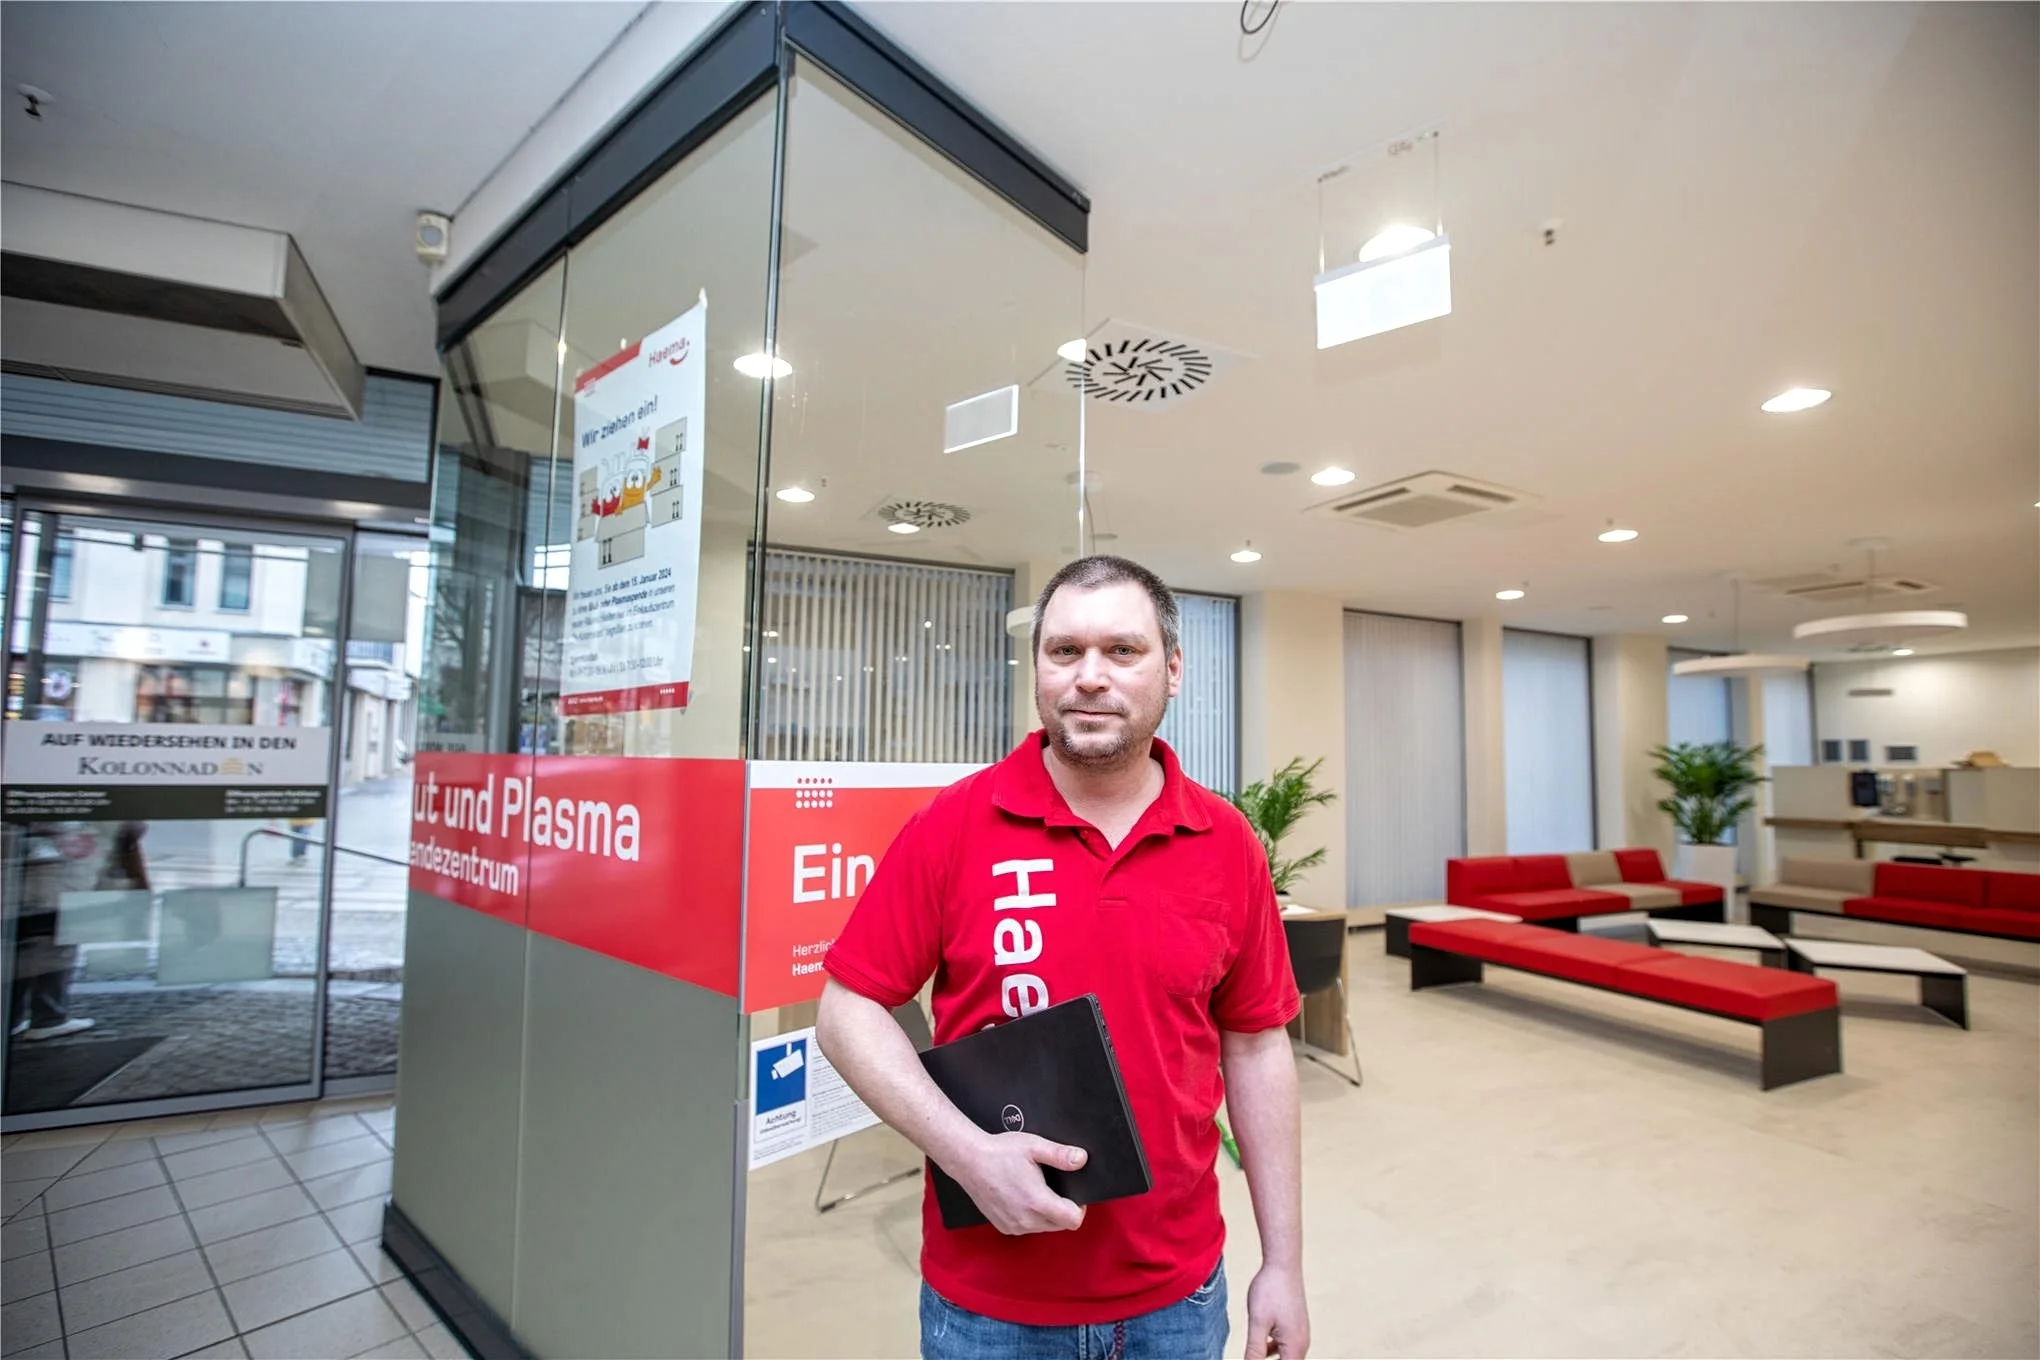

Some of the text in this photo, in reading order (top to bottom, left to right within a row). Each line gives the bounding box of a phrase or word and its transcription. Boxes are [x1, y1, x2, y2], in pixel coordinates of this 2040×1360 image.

[582, 395, 659, 448] Wir ziehen ein!
[639, 573, 657, 585] Januar
[658, 567, 672, 580] 2024
[41, 733, 297, 750] AUF WIEDERSEHEN IN DEN
[444, 773, 494, 834] und
[500, 776, 640, 862] Plasma
[793, 842, 875, 904] Ein
[792, 938, 835, 958] Herzlic
[765, 1110, 798, 1125] Achtung
